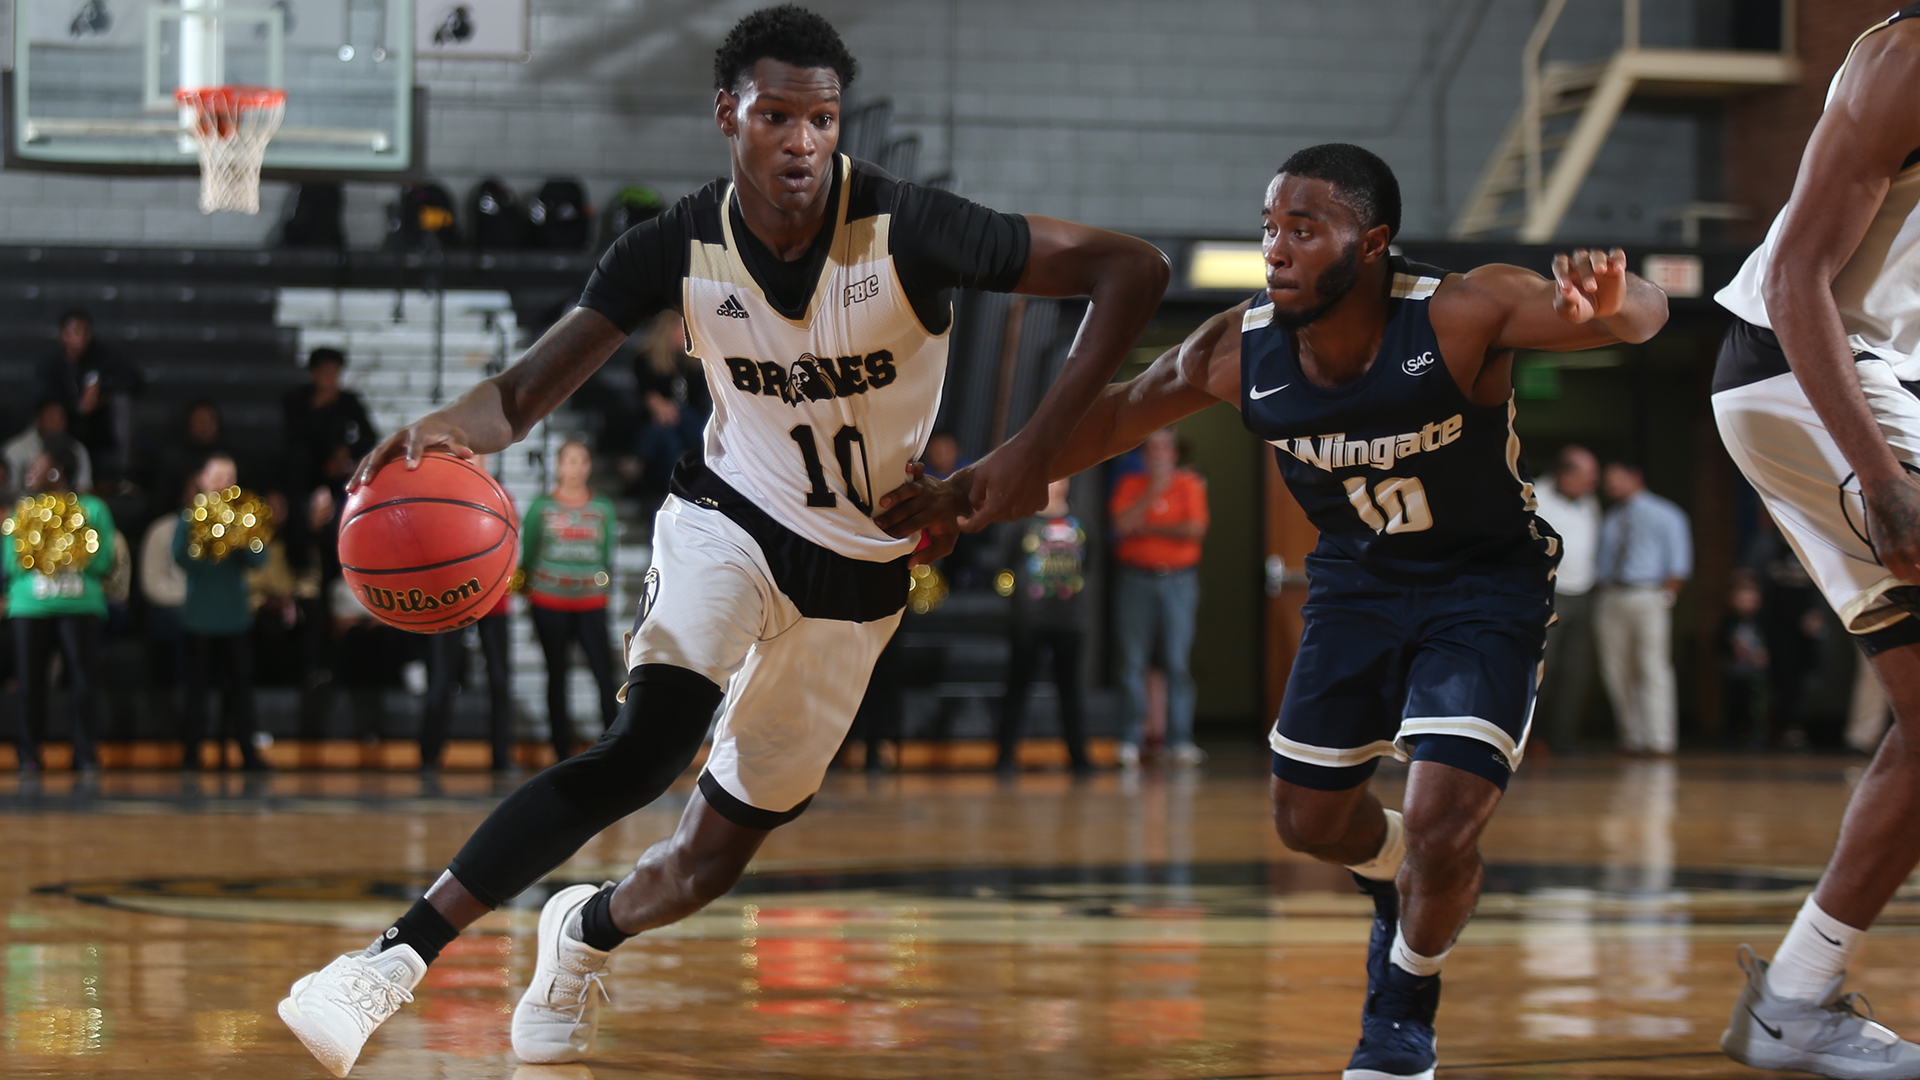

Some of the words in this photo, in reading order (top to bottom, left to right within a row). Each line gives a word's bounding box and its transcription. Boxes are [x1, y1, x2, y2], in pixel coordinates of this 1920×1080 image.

[716, 308, 750, 319] addas
[843, 274, 879, 308] PBC
[725, 349, 897, 404] BRVES
[1407, 351, 1435, 372] SAC
[1264, 413, 1463, 473] Wingate
[789, 424, 874, 517] 10
[1342, 476, 1434, 536] 10
[362, 577, 482, 612] Wilson
